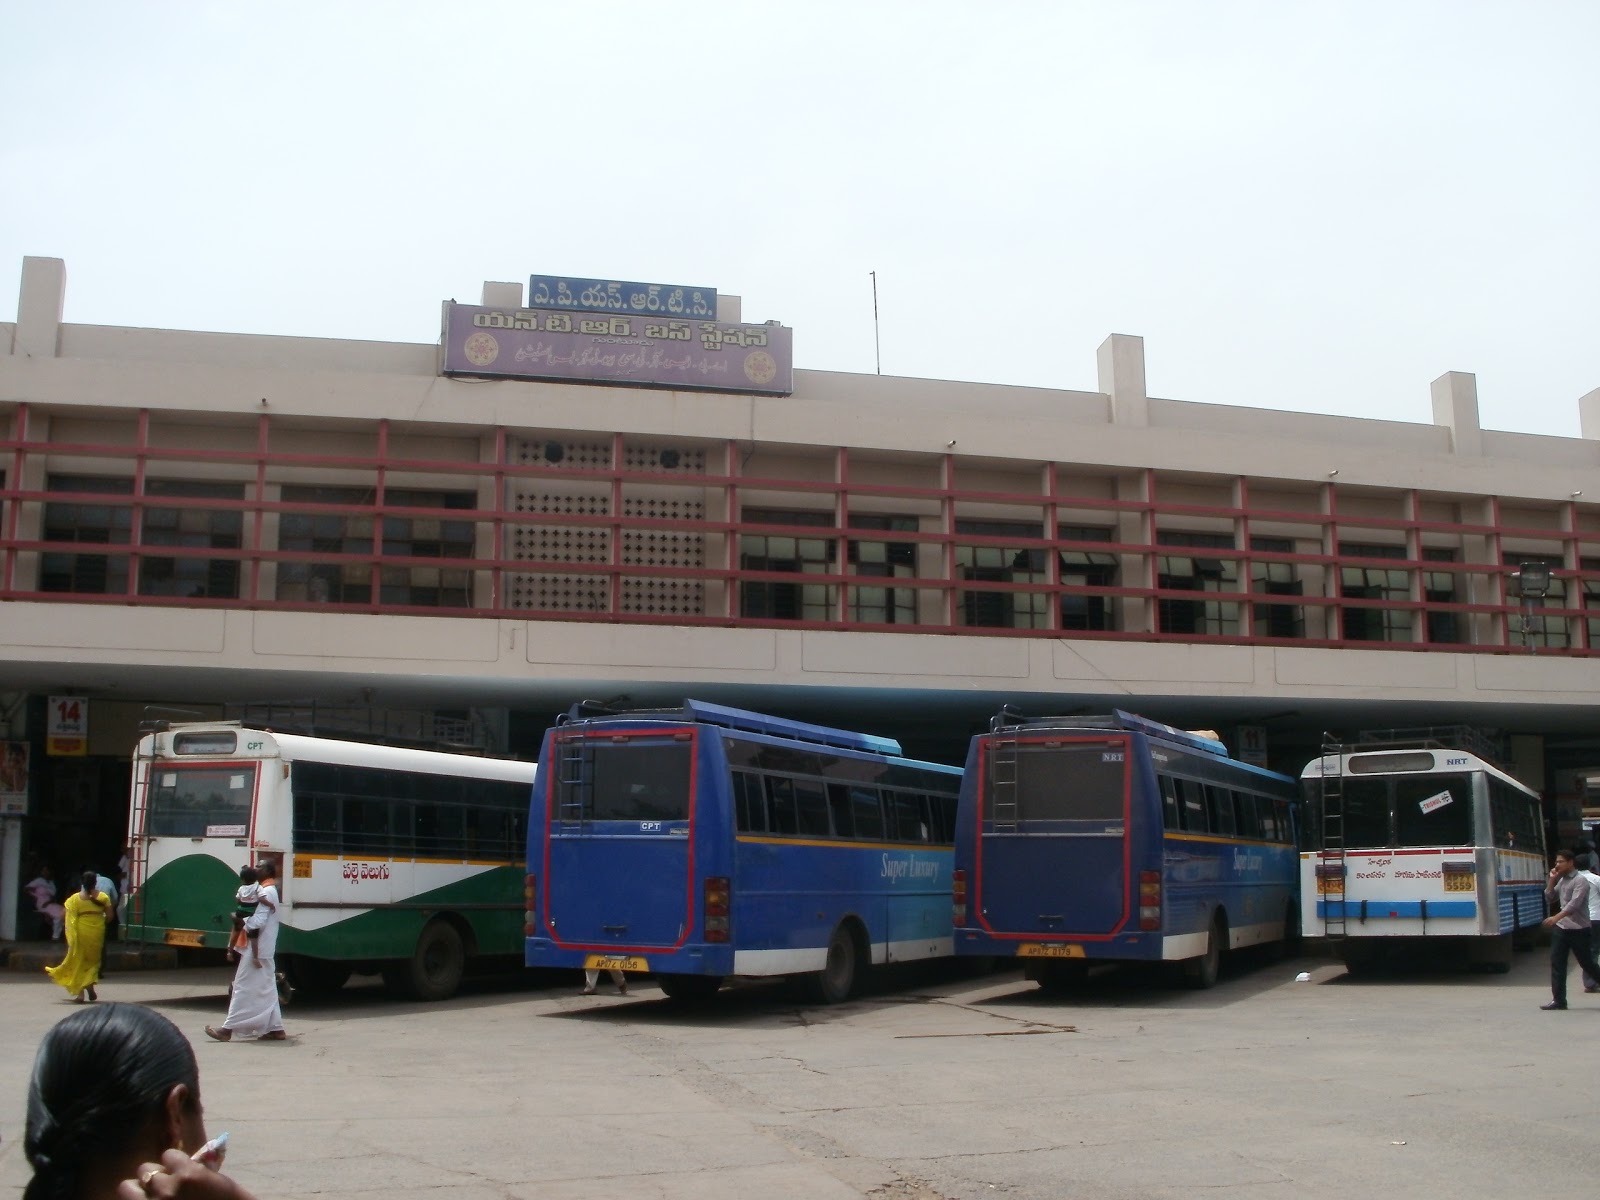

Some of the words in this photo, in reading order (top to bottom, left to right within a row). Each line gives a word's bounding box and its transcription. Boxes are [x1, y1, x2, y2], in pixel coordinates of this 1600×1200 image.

[645, 321, 691, 341] బస్
[699, 323, 768, 350] స్టేషన్
[57, 701, 81, 723] 14
[247, 742, 264, 750] CPT
[1104, 753, 1123, 761] NRT
[641, 822, 660, 830] CPT
[881, 852, 908, 884] Super
[910, 853, 939, 884] Luxury
[343, 862, 359, 884] పల్లె
[361, 863, 390, 880] వెలుగు
[1447, 881, 1472, 890] 5559
[620, 960, 638, 969] 0156
